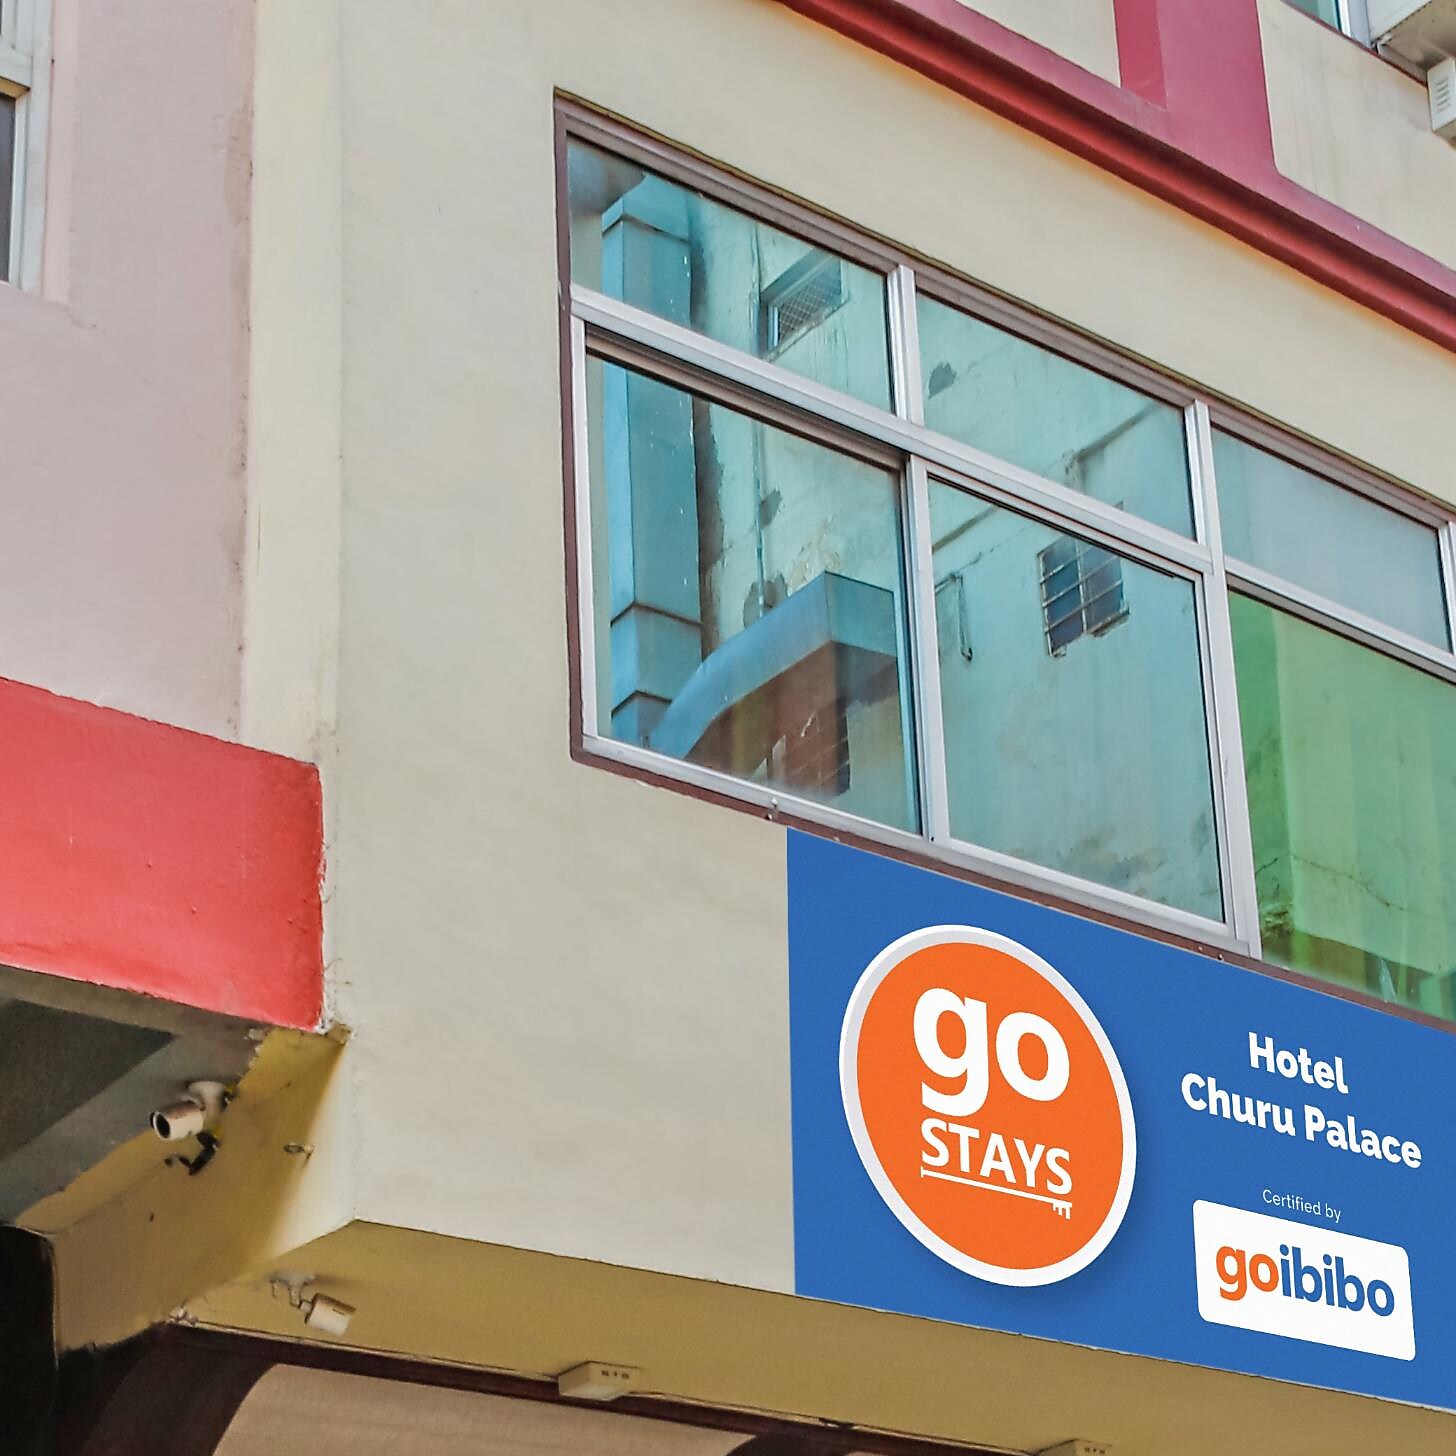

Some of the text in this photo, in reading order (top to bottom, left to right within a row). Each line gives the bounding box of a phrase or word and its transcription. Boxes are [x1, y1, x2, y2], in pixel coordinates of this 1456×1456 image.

[913, 988, 1070, 1117] go
[1248, 1031, 1349, 1094] Hotel
[921, 1117, 1073, 1195] STAYS
[1181, 1072, 1422, 1169] Churu Palace
[1262, 1189, 1341, 1224] Certified by
[1215, 1244, 1395, 1317] goibibo
